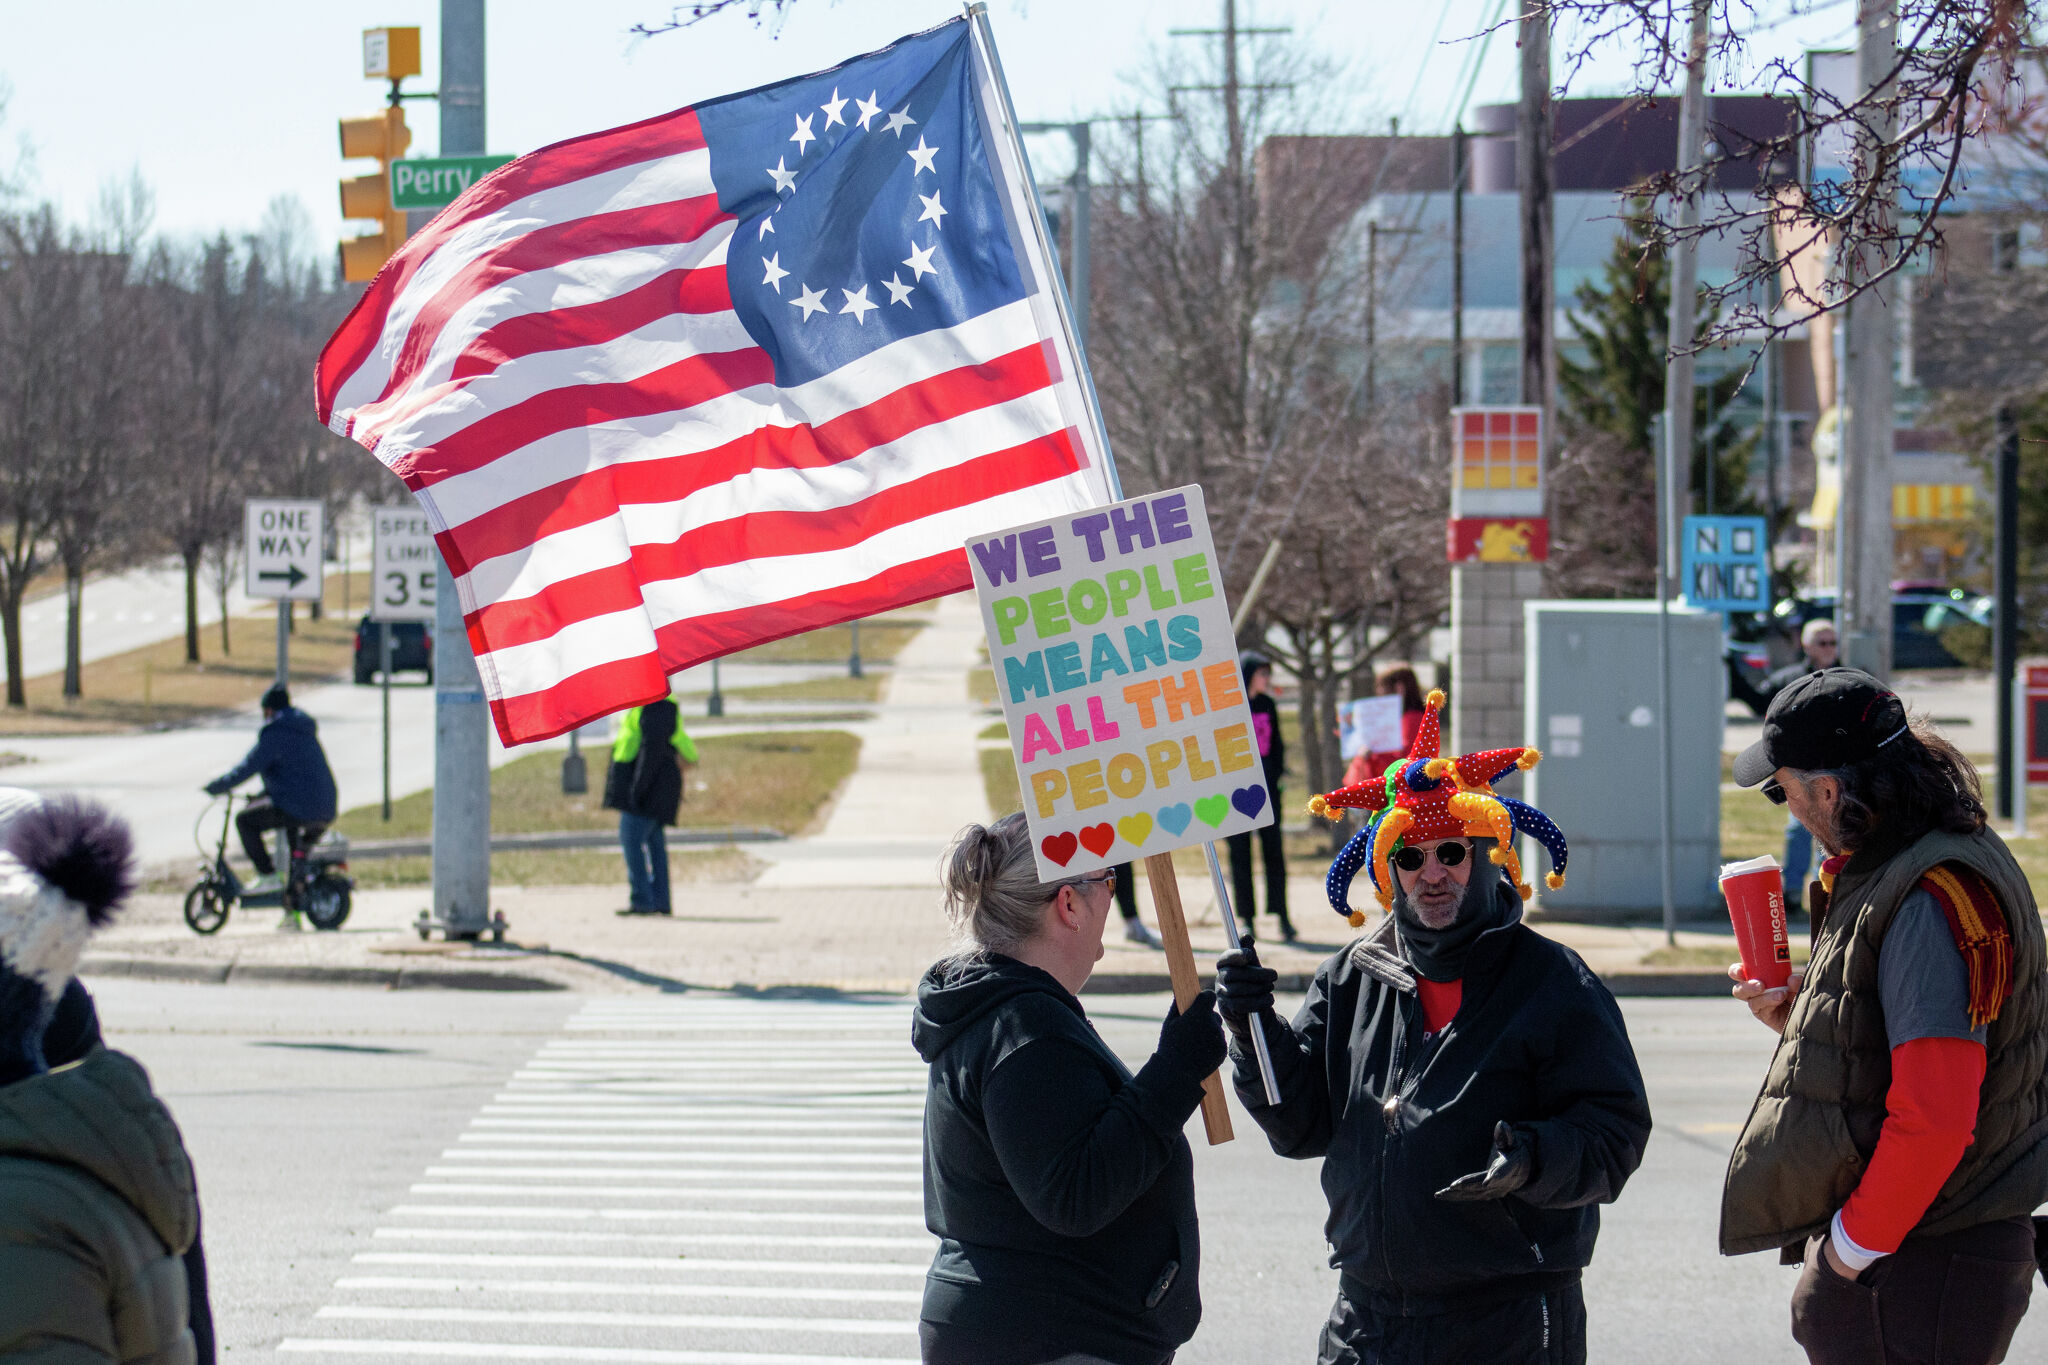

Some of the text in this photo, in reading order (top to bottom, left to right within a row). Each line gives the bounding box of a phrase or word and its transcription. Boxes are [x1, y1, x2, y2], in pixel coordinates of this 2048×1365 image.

[396, 165, 473, 196] Perry
[260, 508, 311, 532] ONE
[379, 519, 434, 537] SPEE
[971, 492, 1193, 588] WE THE
[258, 536, 312, 557] WAY
[384, 571, 436, 607] 35
[991, 552, 1215, 646] PEOPLE
[1693, 562, 1759, 600] KINGS
[1003, 614, 1203, 704] MEANS
[1022, 659, 1244, 764] ALL THE
[1030, 722, 1255, 819] PEOPLE
[1768, 891, 1783, 942] BIGGBY
